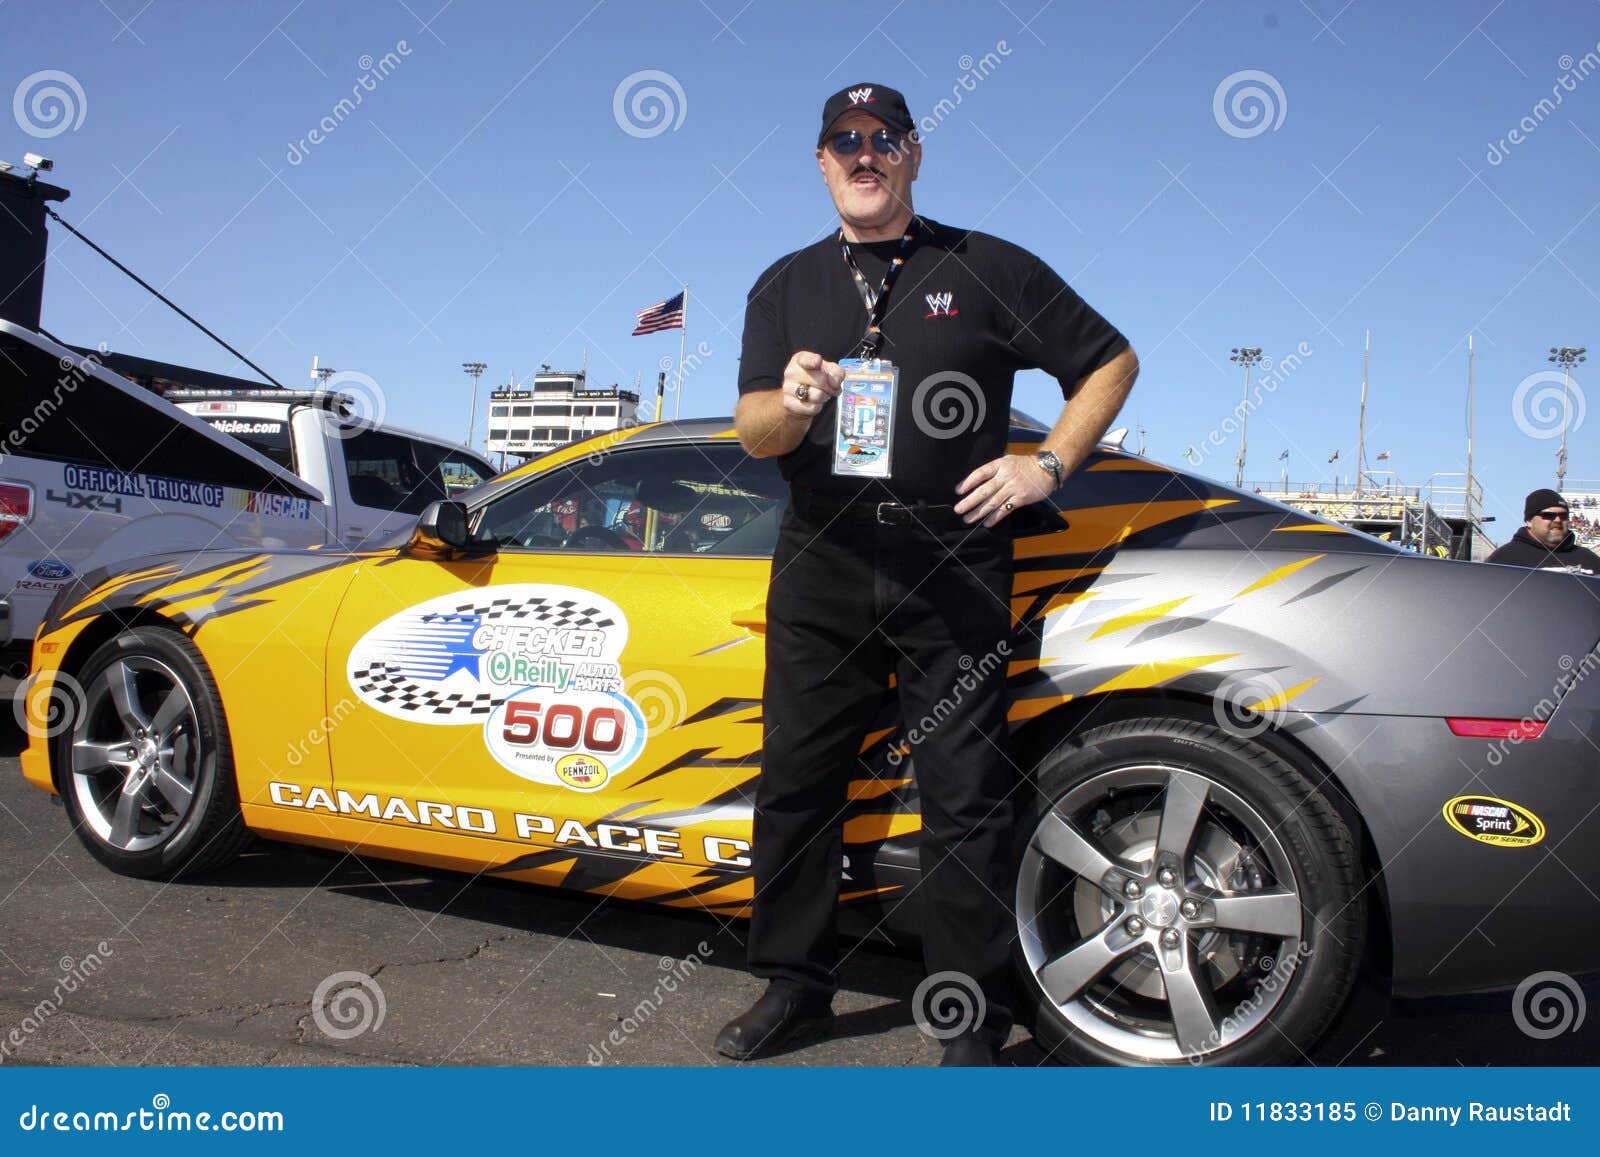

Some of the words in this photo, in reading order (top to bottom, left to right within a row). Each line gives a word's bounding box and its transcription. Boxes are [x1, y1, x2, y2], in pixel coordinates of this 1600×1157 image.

[857, 408, 875, 434] P
[64, 464, 146, 496] OFFICIAL
[147, 478, 203, 505] TRUCK
[203, 486, 225, 508] OF
[254, 491, 311, 520] NASCAR
[36, 562, 66, 578] Ford
[472, 624, 606, 657] CHECKER
[576, 663, 618, 678] AUTO
[574, 677, 621, 693] PARTS
[503, 701, 626, 752] 500
[515, 752, 546, 761] Presented
[547, 755, 554, 764] by
[563, 765, 601, 777] PENNZOIL
[1471, 804, 1509, 818] NASCAR
[269, 782, 497, 834] CAMARO
[513, 812, 684, 859] PACE
[1476, 817, 1512, 831] Sprint
[1480, 834, 1499, 842] CUP
[1499, 836, 1532, 844] SERIES
